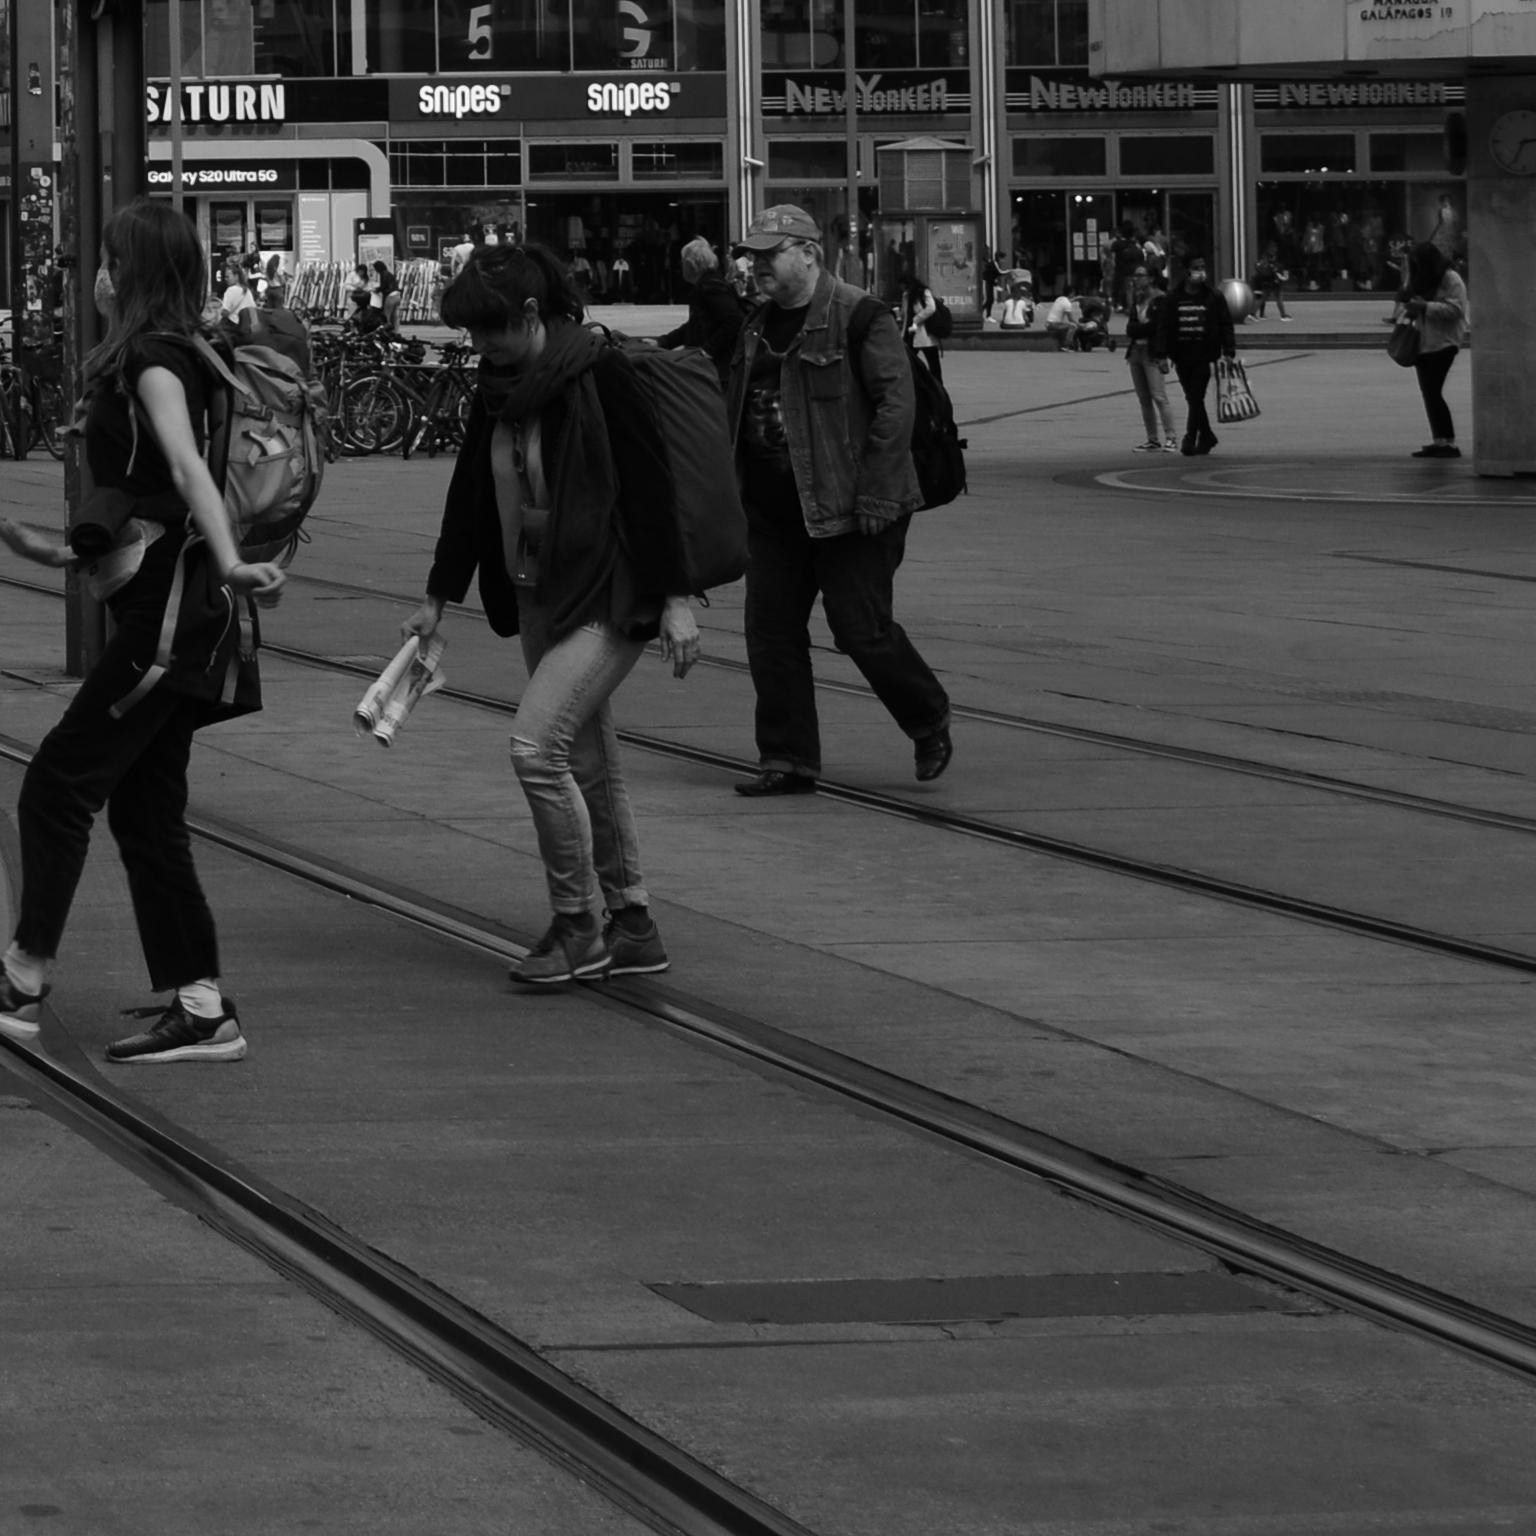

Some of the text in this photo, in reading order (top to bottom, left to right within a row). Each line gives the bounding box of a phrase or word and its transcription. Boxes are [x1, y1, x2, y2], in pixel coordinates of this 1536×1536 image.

[1360, 8, 1432, 21] GALÁPAGOS
[147, 170, 278, 186] Galxy S20 Ultra 5G
